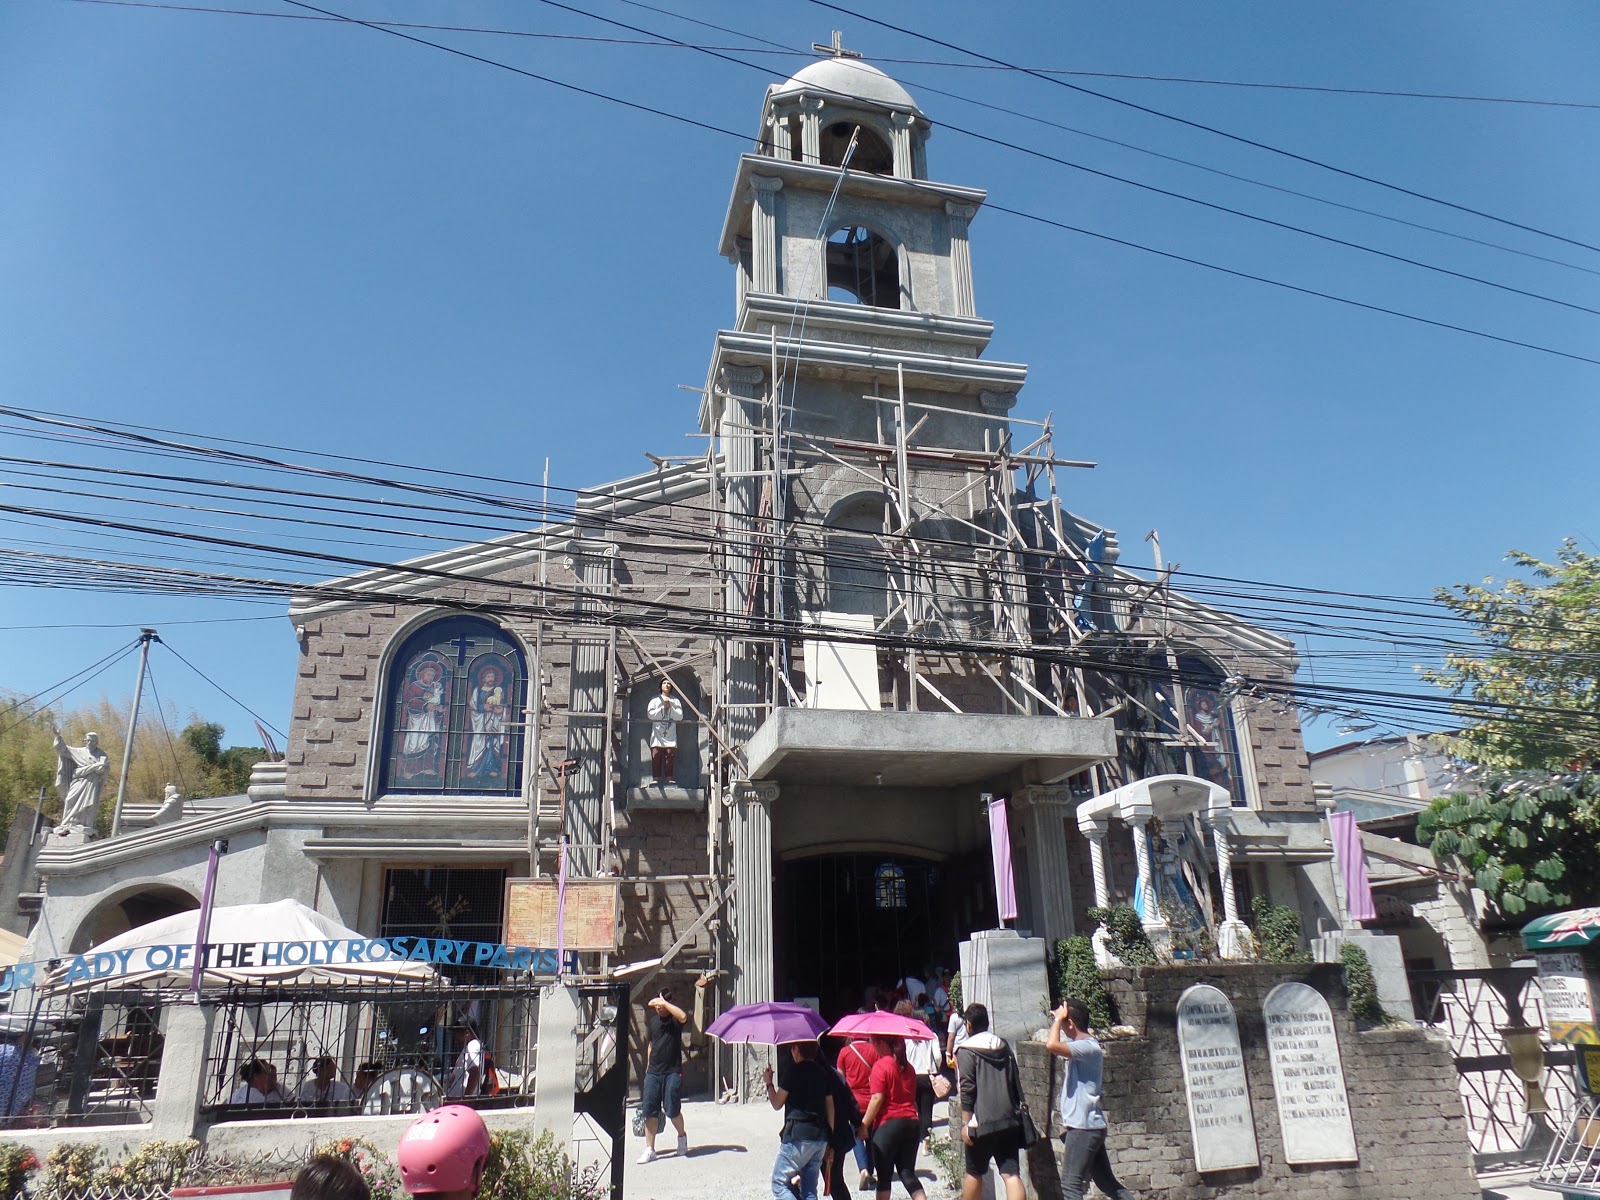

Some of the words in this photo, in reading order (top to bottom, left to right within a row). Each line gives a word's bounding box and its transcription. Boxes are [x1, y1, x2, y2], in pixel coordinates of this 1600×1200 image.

[64, 949, 135, 983] ADY
[146, 944, 191, 970] OF
[201, 942, 257, 969] THE
[262, 939, 340, 967] HOLY
[346, 936, 469, 965] ROSARY
[475, 942, 578, 975] PARISH
